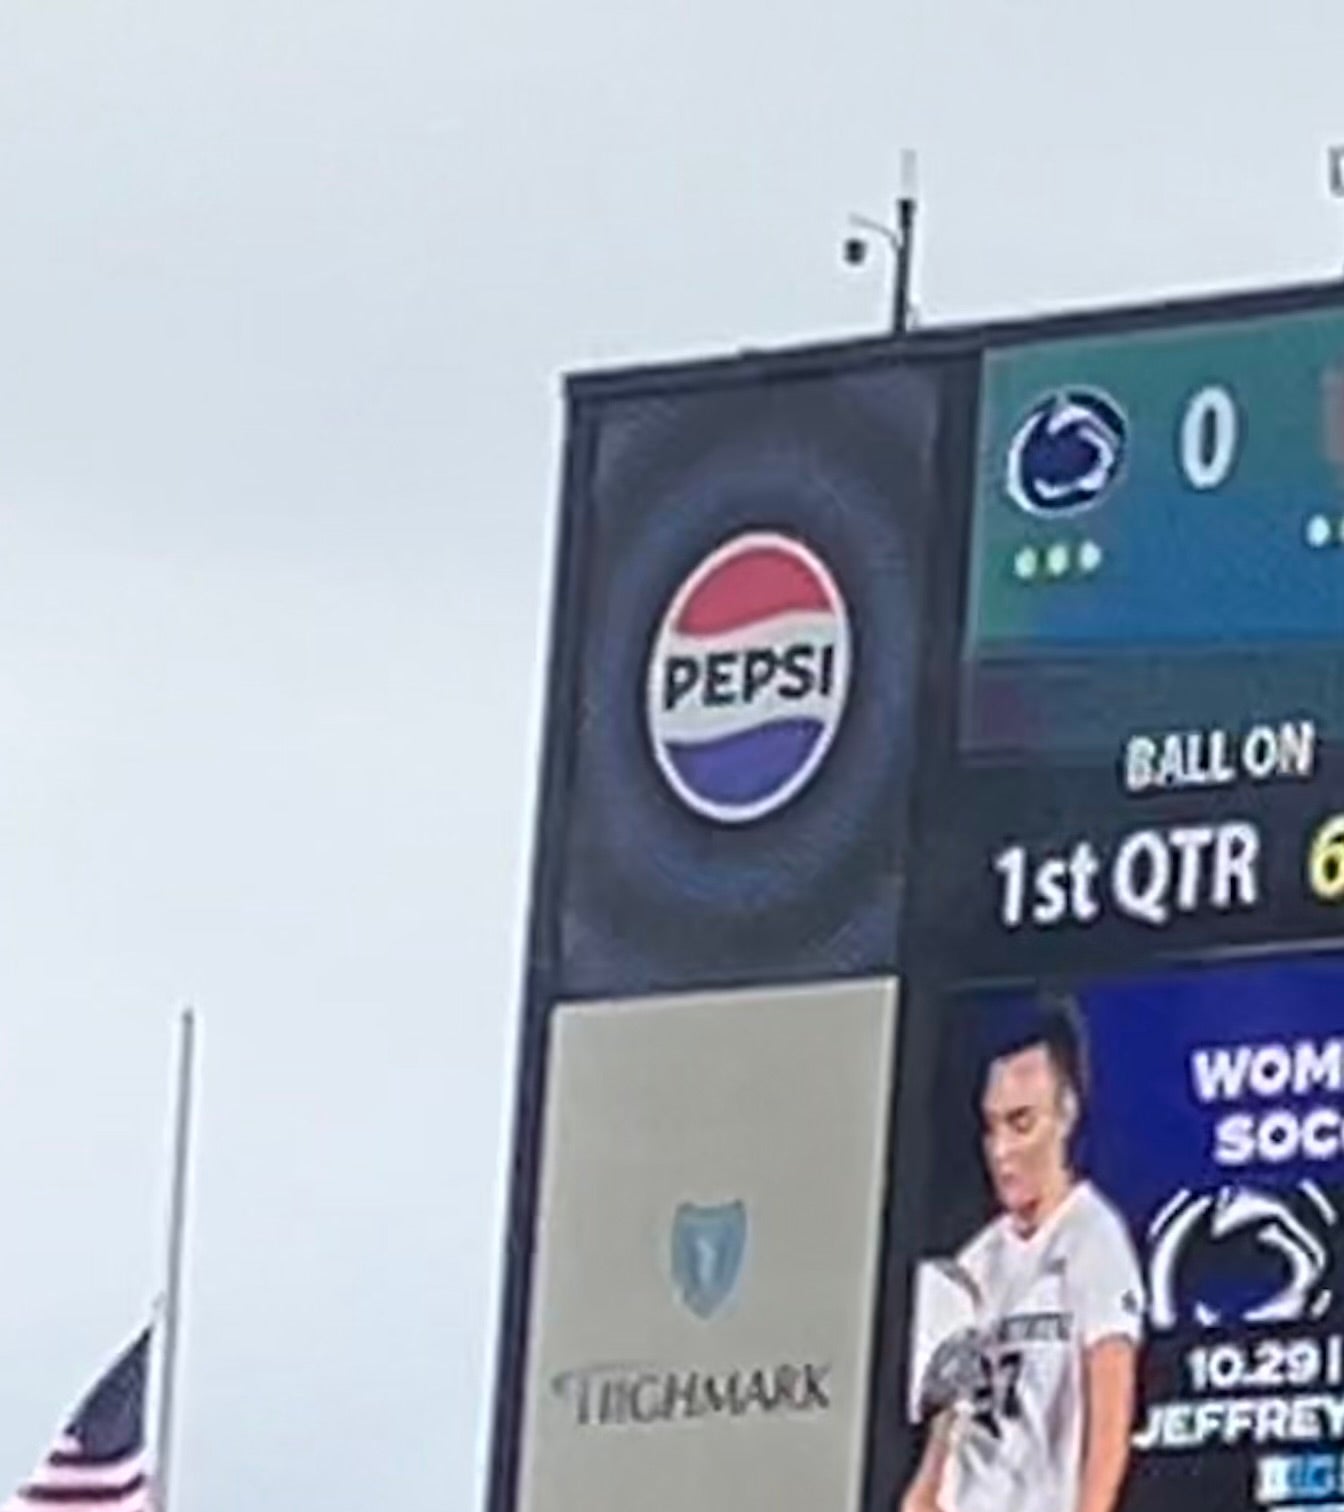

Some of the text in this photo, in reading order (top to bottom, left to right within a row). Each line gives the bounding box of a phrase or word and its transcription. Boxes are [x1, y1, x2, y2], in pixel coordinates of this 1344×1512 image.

[1181, 386, 1236, 490] 0
[664, 642, 836, 711] PEPSI
[1124, 719, 1316, 791] BALL ON
[995, 842, 1099, 926] 1st
[1110, 820, 1261, 923] QTR
[1186, 1337, 1320, 1390] 10.29
